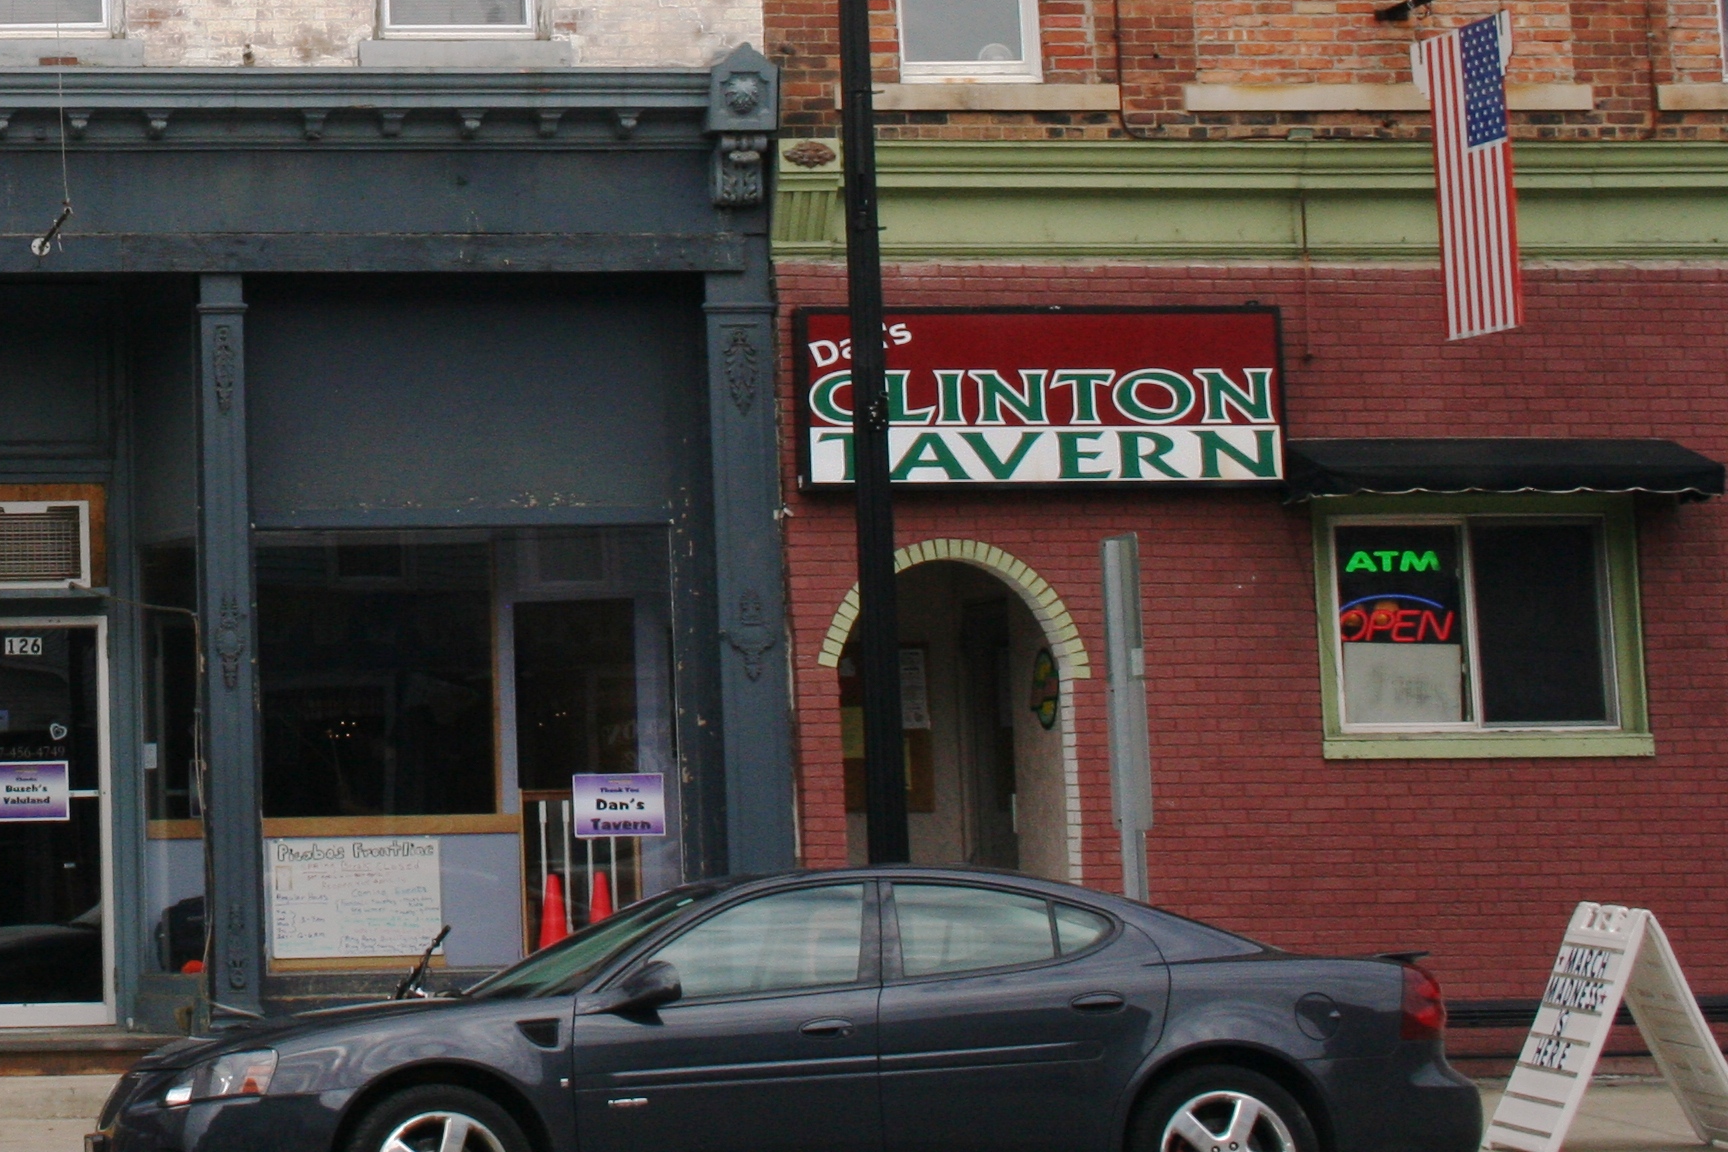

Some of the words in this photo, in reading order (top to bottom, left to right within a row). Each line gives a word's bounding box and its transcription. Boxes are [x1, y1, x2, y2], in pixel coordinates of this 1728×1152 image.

[808, 321, 913, 368] Da's
[809, 367, 1273, 425] CLINTON
[819, 430, 1277, 481] TAVERN
[1345, 550, 1440, 573] ATM
[1339, 608, 1455, 643] OPEN
[8, 638, 41, 654] 126
[3, 796, 51, 805] Valuland
[5, 784, 48, 793] Busch's
[595, 797, 645, 811] Dan's
[590, 818, 652, 831] Tavern
[352, 840, 434, 858] Frontline
[1563, 947, 1610, 980] MARCH
[1544, 976, 1605, 1011] MADNESS
[1551, 1009, 1570, 1037] IS
[1531, 1038, 1571, 1070] HERE
